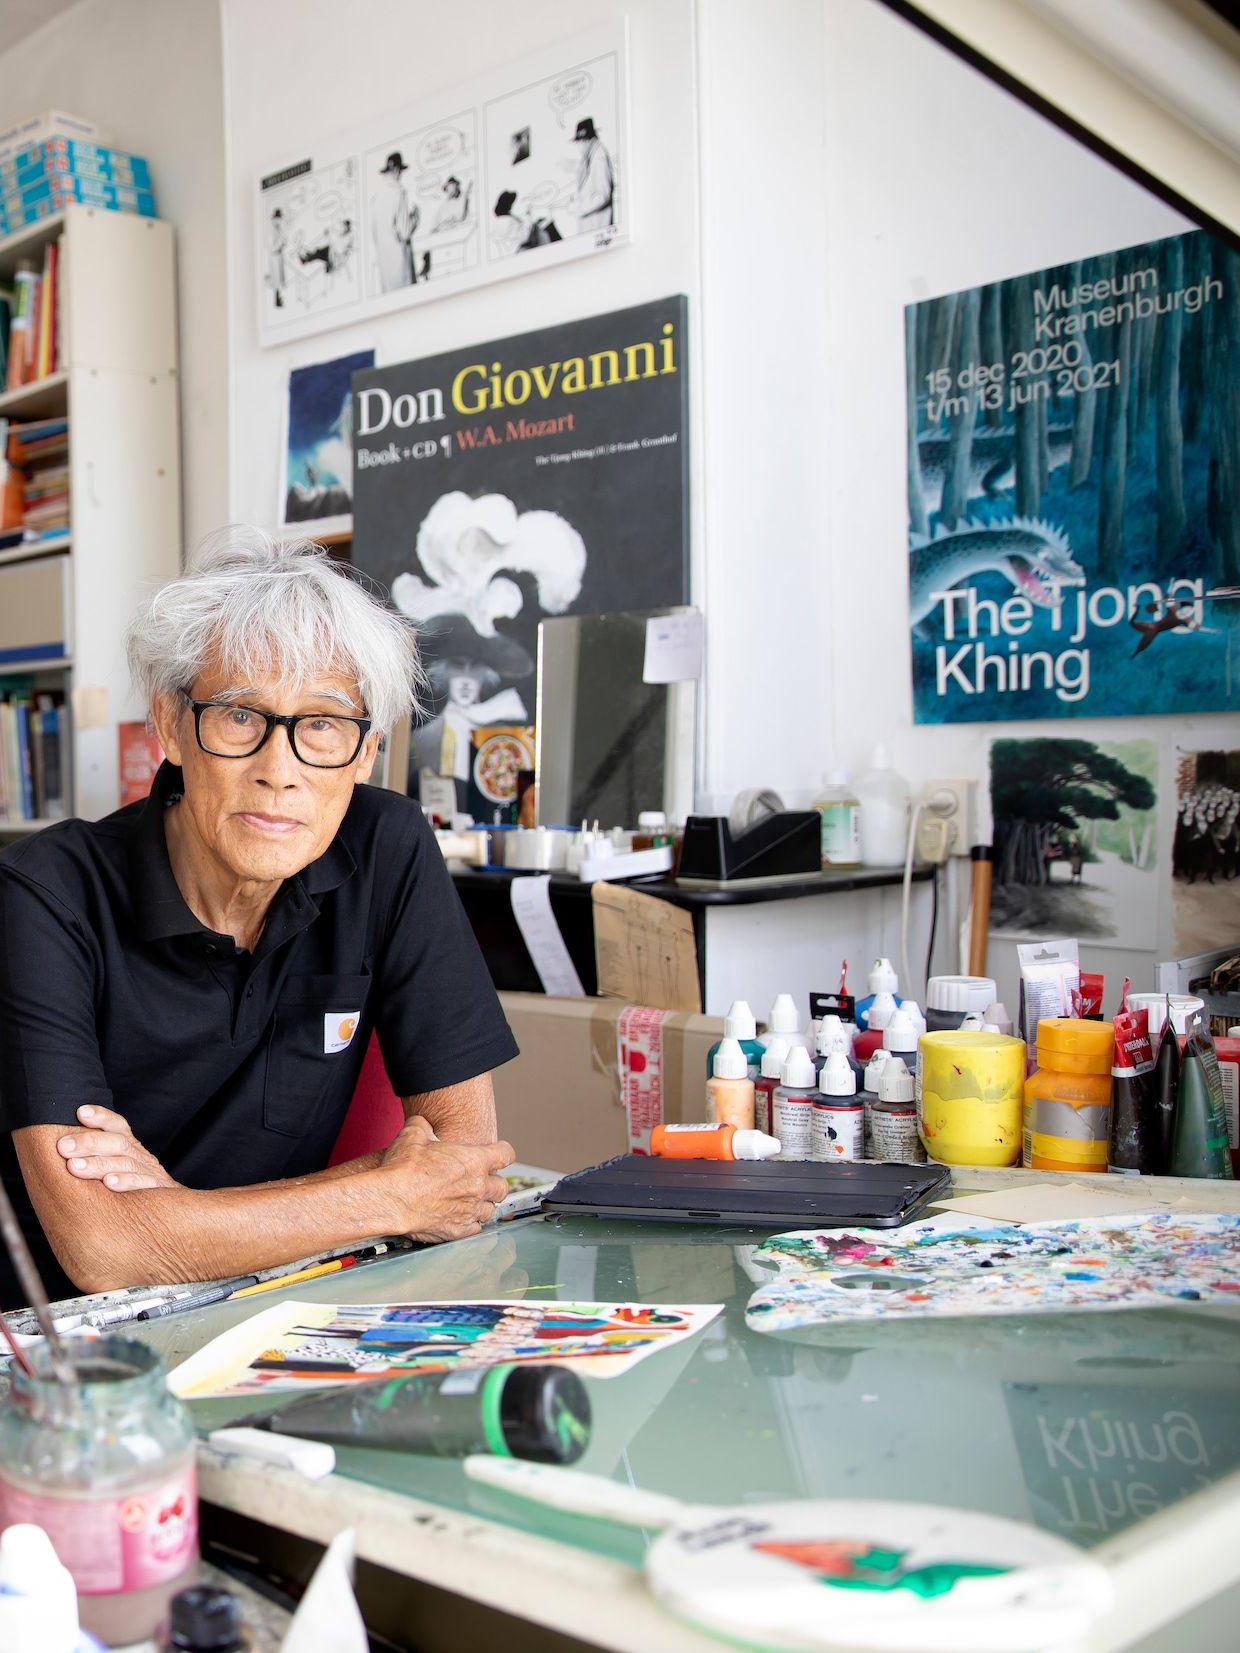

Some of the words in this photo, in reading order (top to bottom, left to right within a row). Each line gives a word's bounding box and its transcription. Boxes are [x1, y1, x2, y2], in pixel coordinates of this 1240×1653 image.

[1033, 267, 1157, 314] Museum
[1035, 276, 1223, 341] Kranenburgh
[357, 388, 446, 435] Don
[452, 323, 677, 414] Giovanni
[925, 368, 952, 395] 15
[957, 362, 1005, 390] dec
[1011, 340, 1082, 378] 2020
[925, 390, 969, 423] t/m
[978, 384, 1004, 411] 13
[1007, 380, 1050, 412] jun
[1056, 359, 1121, 396] 2021
[456, 425, 503, 450] W.A.
[506, 412, 575, 442] Mozart
[936, 641, 1090, 702] Khing
